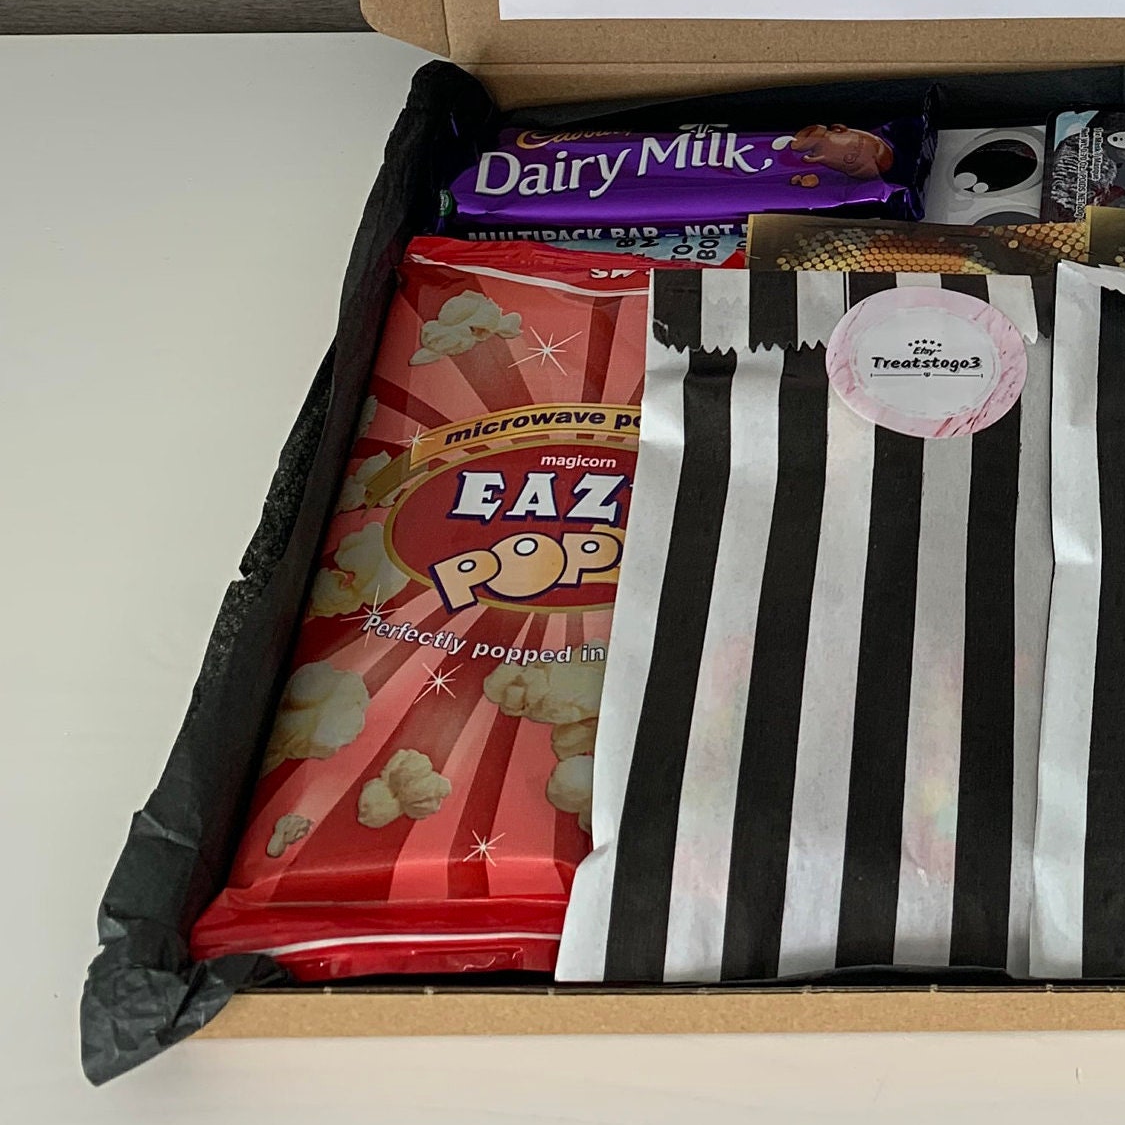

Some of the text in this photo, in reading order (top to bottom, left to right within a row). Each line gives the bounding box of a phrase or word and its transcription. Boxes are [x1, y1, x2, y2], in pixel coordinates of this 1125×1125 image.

[474, 125, 773, 199] Dairy Milk
[684, 225, 734, 237] NOT
[871, 356, 982, 373] Treatstogo3
[444, 410, 606, 447] microwave
[540, 454, 617, 471] magicorn
[448, 471, 634, 525] EAZ
[429, 532, 623, 614] POP
[362, 613, 606, 667] Perfectly popped in
